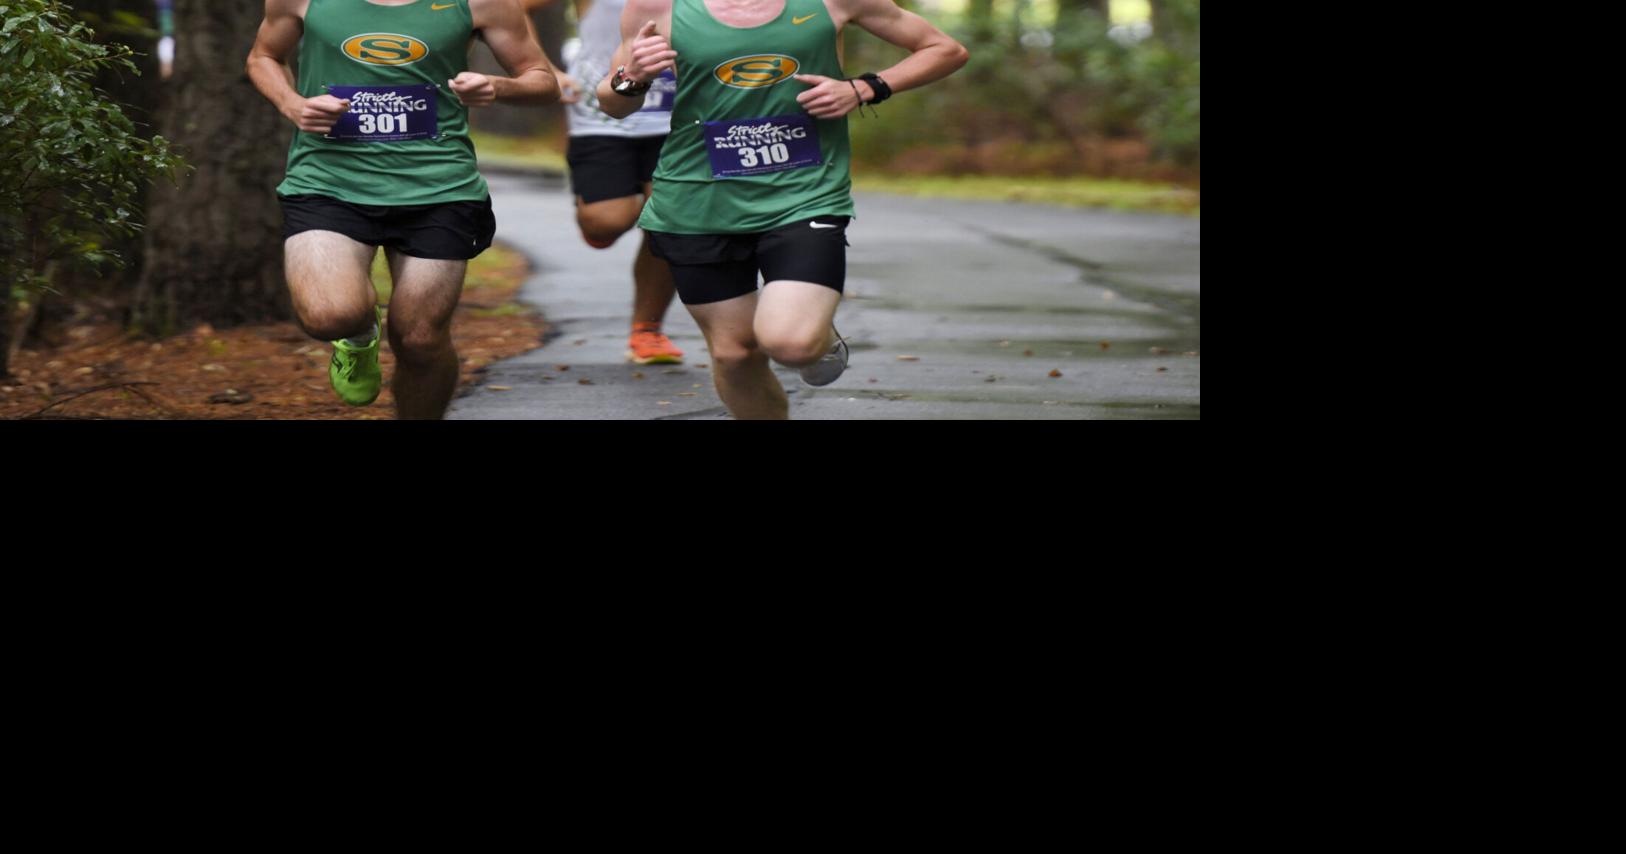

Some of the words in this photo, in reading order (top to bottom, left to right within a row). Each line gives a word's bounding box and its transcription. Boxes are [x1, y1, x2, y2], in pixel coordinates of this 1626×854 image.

[359, 38, 412, 61] S
[731, 57, 783, 84] S
[348, 99, 427, 114] UNNING
[351, 91, 412, 106] Strictly
[358, 113, 408, 134] 301
[727, 122, 789, 138] Strictly
[713, 127, 807, 149] RUNNING
[738, 142, 790, 168] 310
